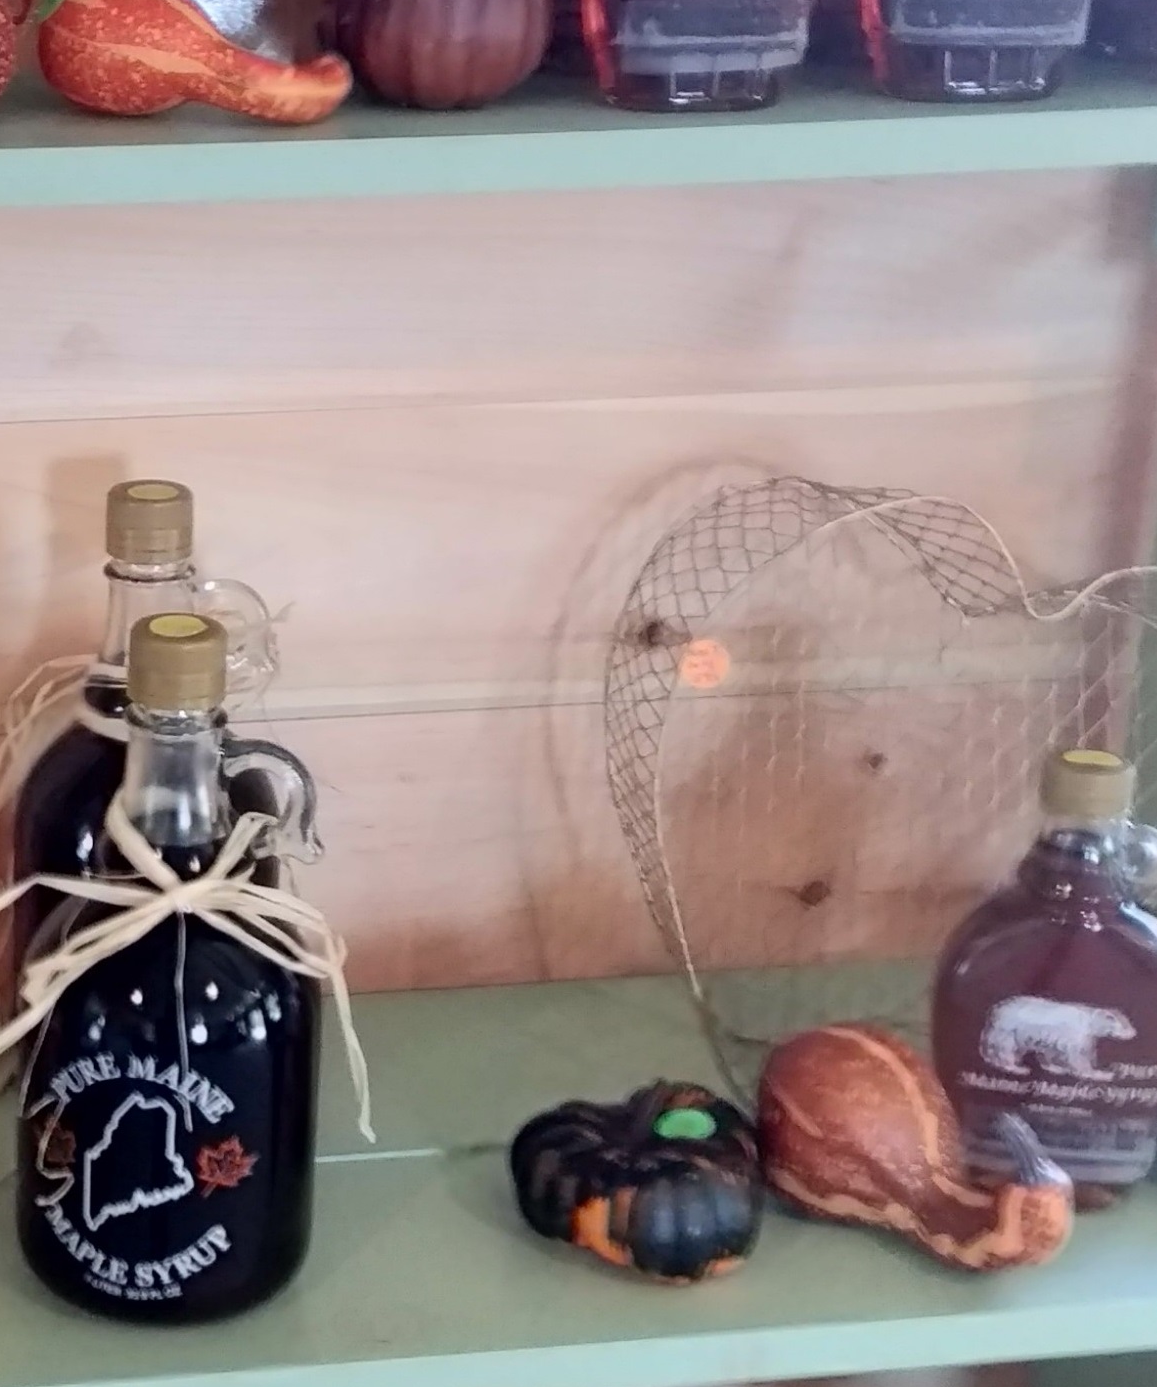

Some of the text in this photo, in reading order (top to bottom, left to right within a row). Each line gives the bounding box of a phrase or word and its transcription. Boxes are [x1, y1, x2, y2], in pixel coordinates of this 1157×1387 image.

[49, 1052, 235, 1124] PURE MAINE
[44, 1202, 231, 1287] MAPLE SYRUP
